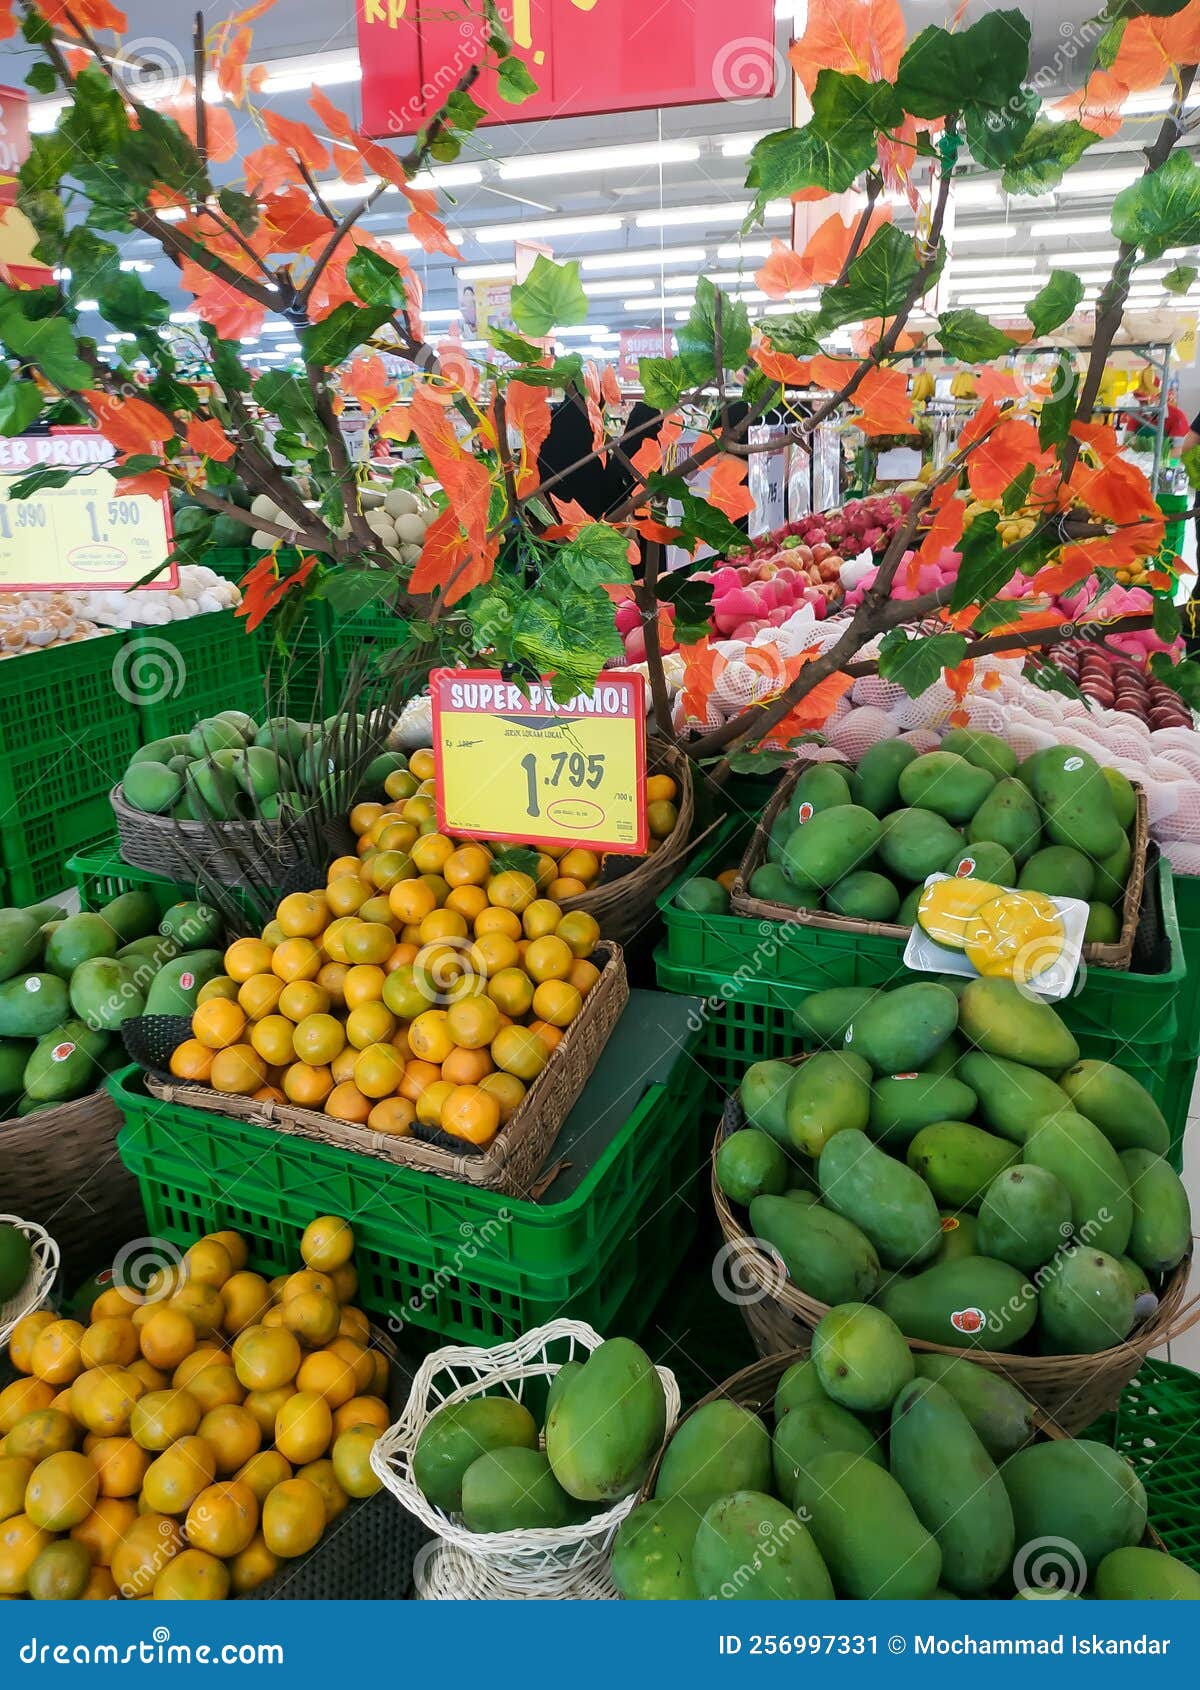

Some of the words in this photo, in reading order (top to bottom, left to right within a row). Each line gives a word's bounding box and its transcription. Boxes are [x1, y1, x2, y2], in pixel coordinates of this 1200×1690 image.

[451, 683, 523, 711] SUPER
[529, 685, 629, 715] PRMO!
[521, 751, 605, 817] 1.795
